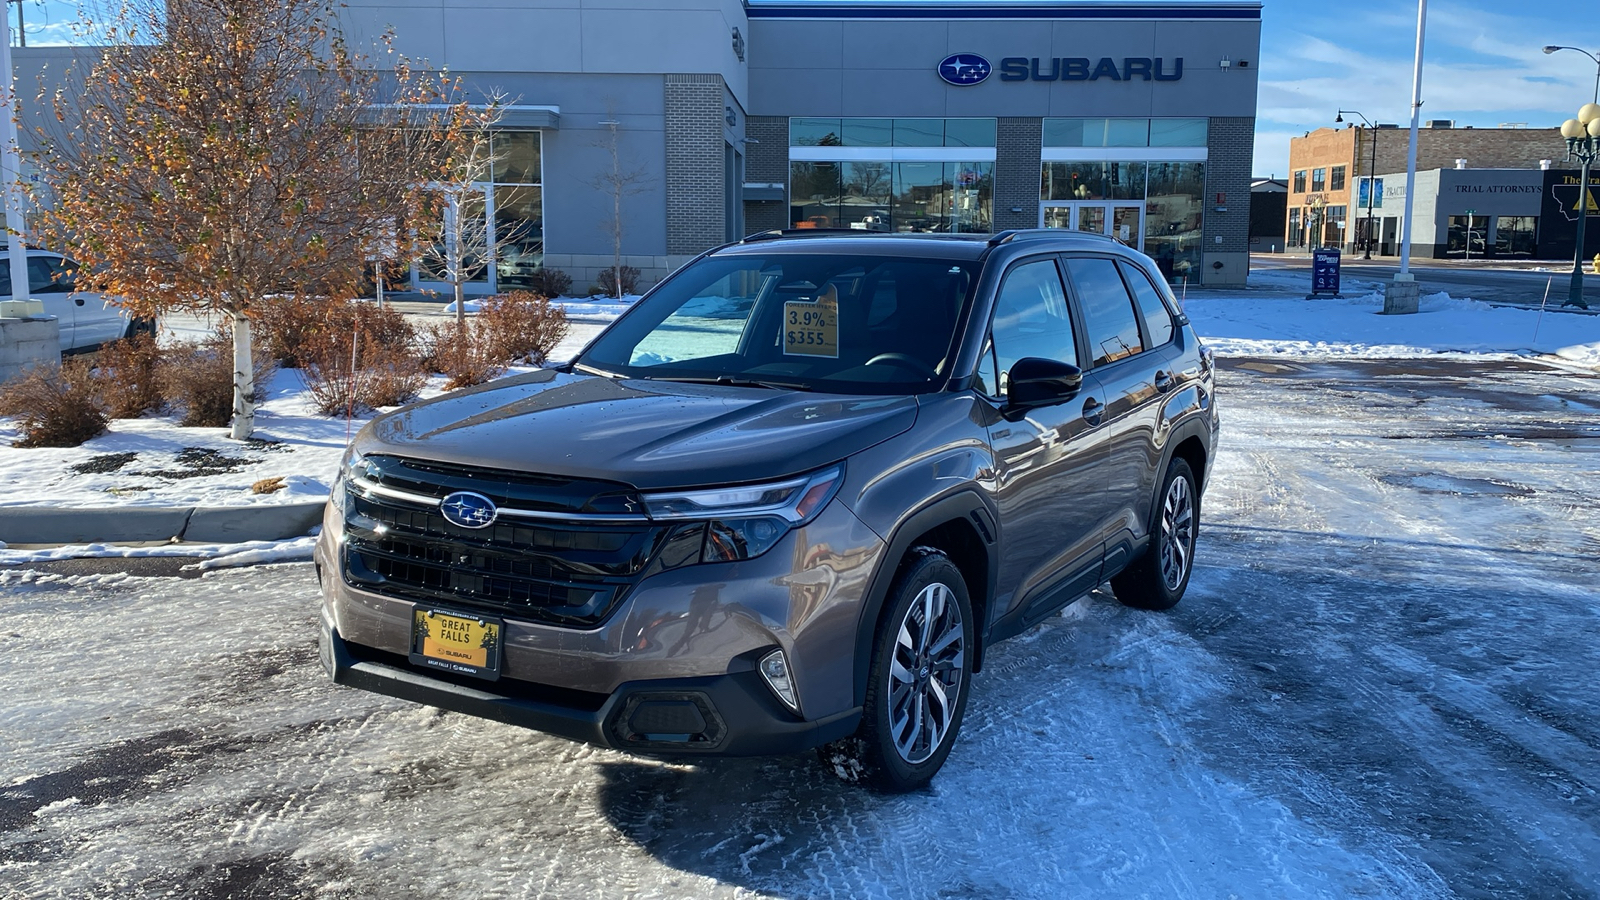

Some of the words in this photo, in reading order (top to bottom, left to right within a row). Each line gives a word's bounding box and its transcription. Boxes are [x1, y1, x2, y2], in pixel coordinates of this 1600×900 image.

[1000, 57, 1184, 81] SUBARU
[1562, 176, 1581, 184] The
[1455, 185, 1485, 193] TRIAL
[1486, 185, 1543, 193] ATTORNEYS
[789, 311, 825, 327] 3.9%
[788, 331, 824, 345] $355
[442, 619, 470, 632] GREAT
[441, 630, 469, 643] FALLS
[445, 650, 472, 659] SUBARU
